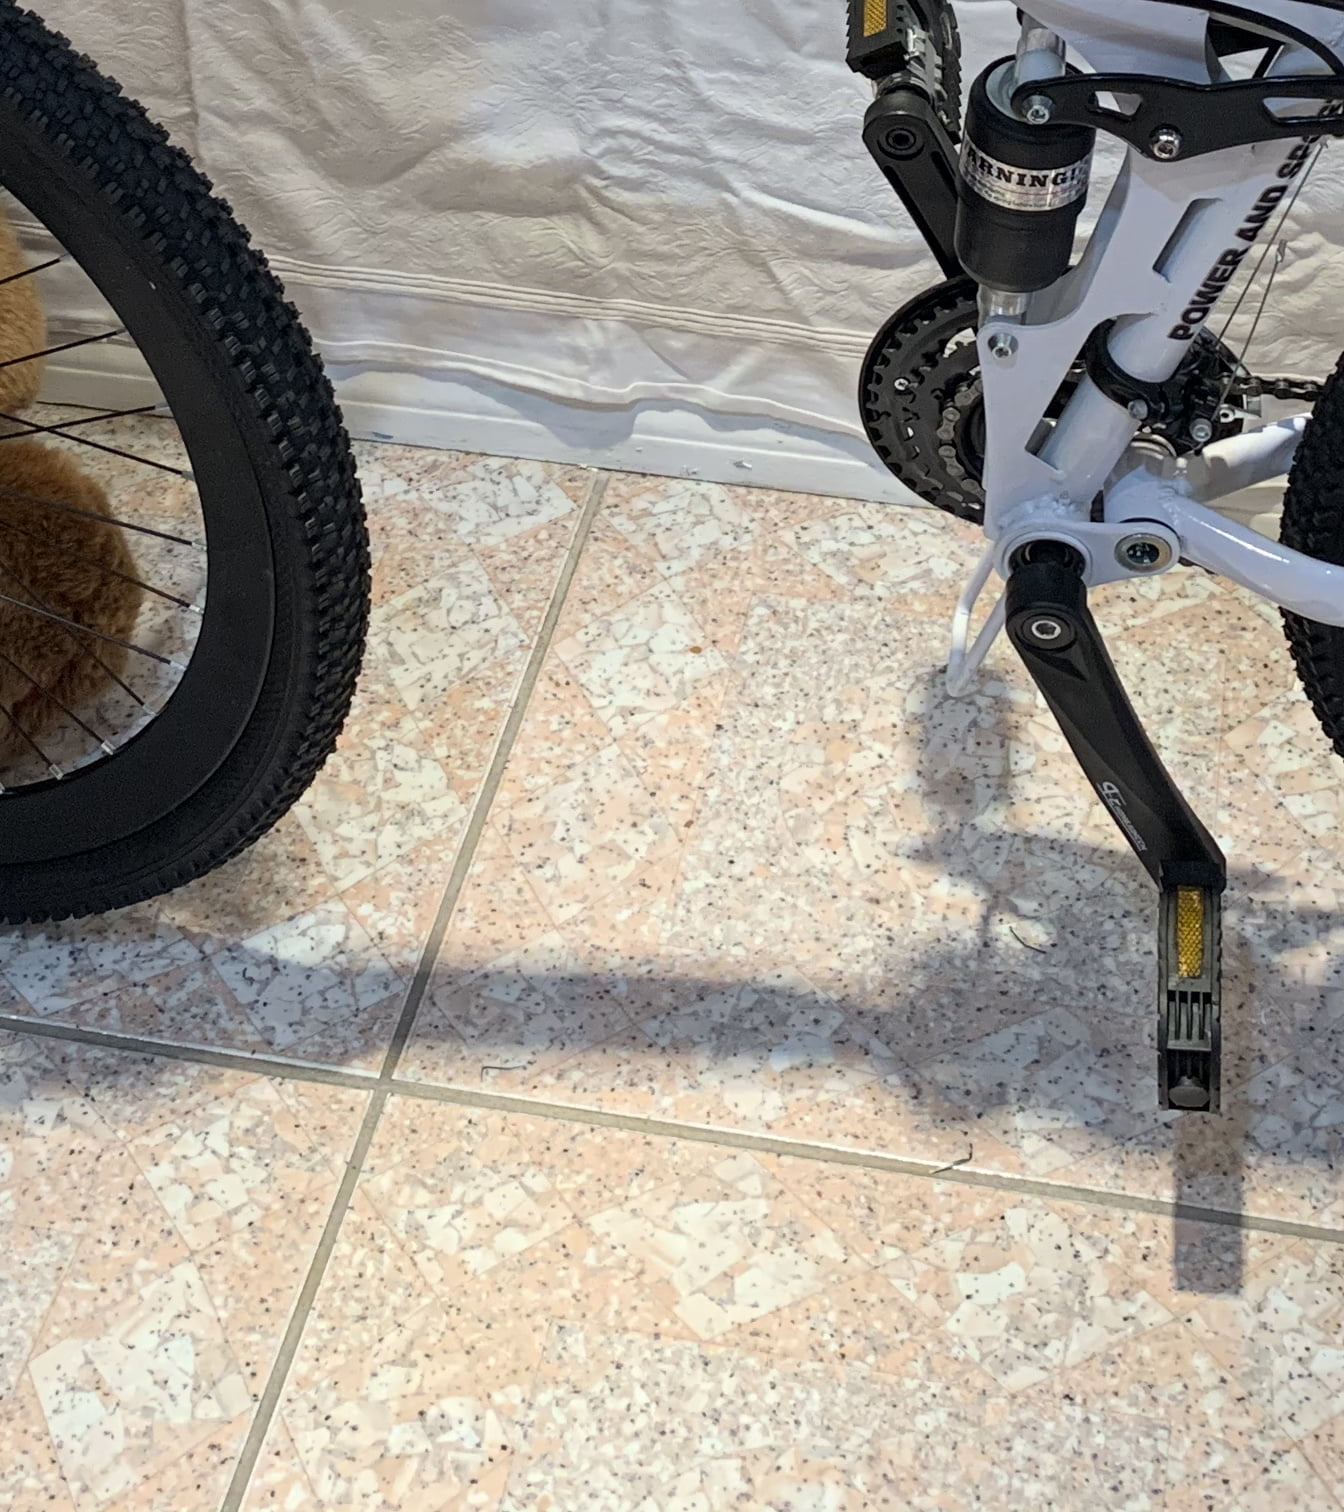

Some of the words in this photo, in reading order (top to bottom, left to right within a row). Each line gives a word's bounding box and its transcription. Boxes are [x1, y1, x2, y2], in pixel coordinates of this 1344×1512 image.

[967, 146, 1077, 188] ARNING!
[1167, 247, 1251, 341] POWER
[1235, 185, 1289, 242] AND
